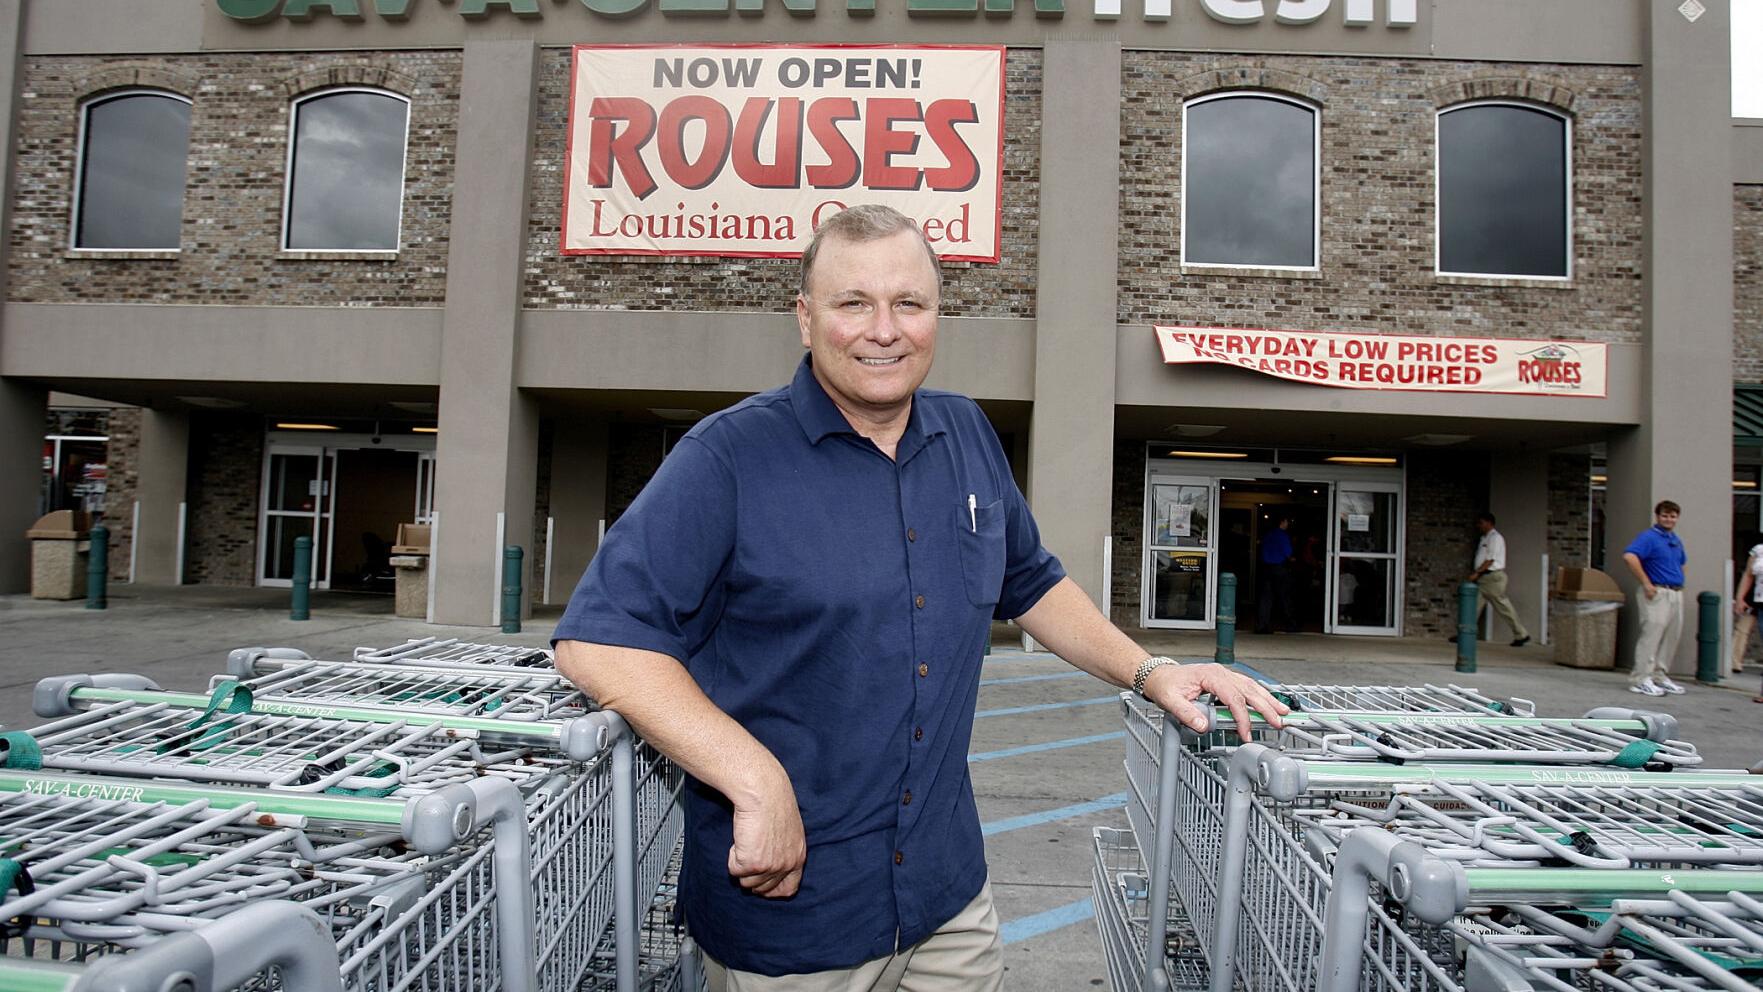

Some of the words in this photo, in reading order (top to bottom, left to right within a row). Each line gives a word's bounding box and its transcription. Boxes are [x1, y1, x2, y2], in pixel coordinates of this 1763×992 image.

[653, 57, 763, 88] NOW
[778, 57, 922, 89] OPEN!
[587, 95, 981, 201] ROUSES
[589, 199, 796, 240] Louisiana
[1171, 333, 1318, 357] EVERYDAY
[1328, 339, 1389, 360] LOW
[1398, 342, 1498, 364] PRICES
[1193, 346, 1230, 361] NO
[1238, 357, 1329, 380] CARDS
[1339, 361, 1482, 385] REQUIRED
[1518, 359, 1581, 384] ROUSES
[22, 779, 144, 802] SAV-A-CENTER
[1531, 768, 1633, 784] SAV-A-CENTER
